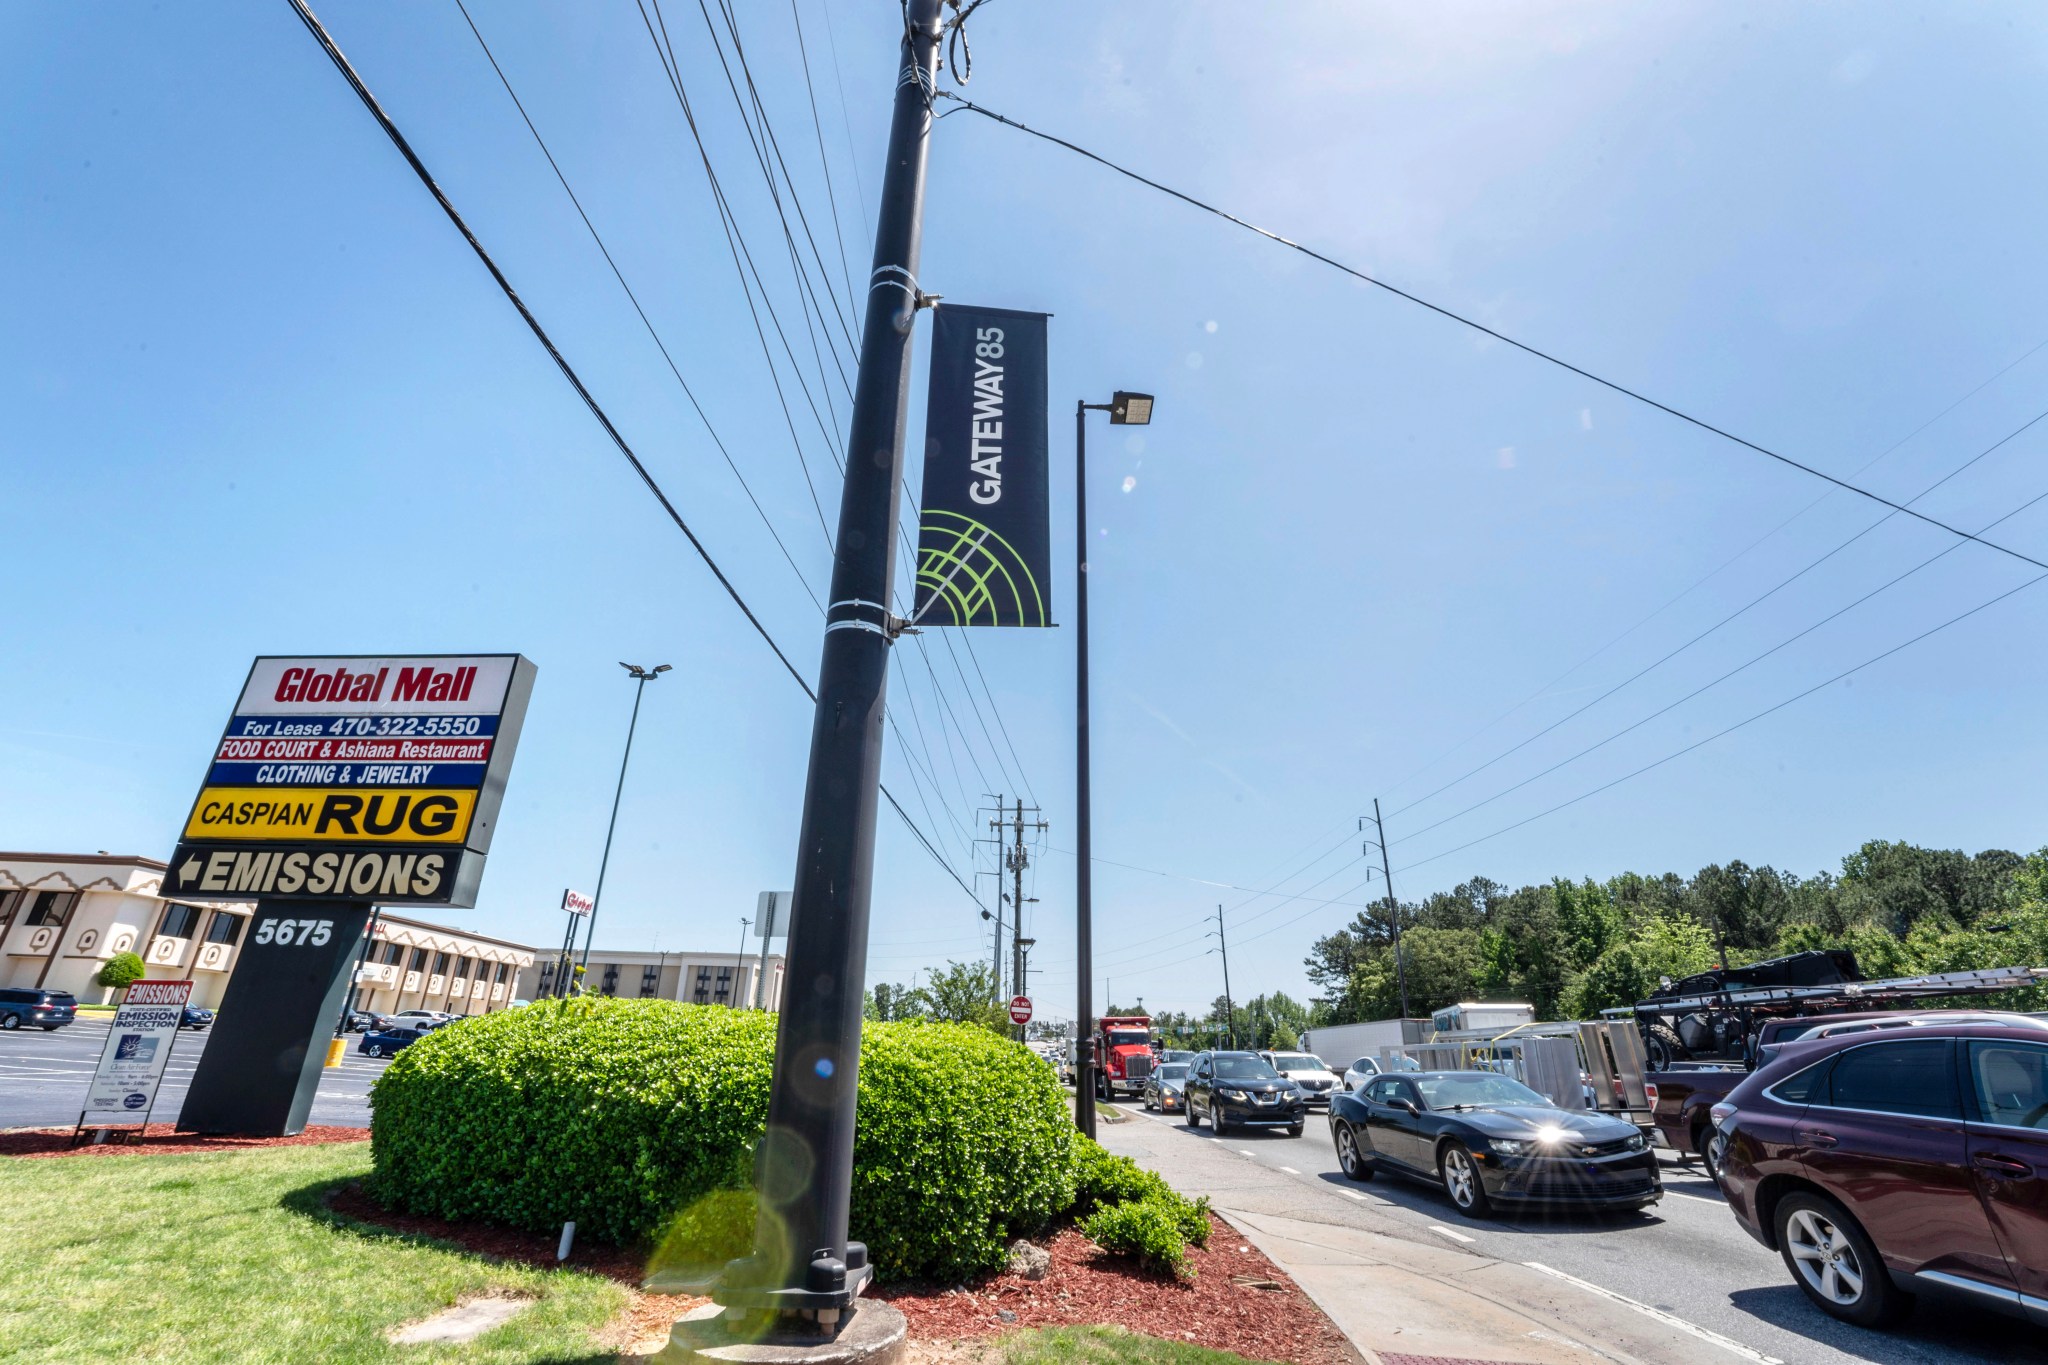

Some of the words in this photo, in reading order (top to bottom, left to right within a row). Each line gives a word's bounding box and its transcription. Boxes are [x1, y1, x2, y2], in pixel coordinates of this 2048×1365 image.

[274, 667, 389, 703] Global
[391, 666, 478, 702] Mall
[243, 720, 272, 736] For
[273, 720, 323, 736] Lease
[329, 717, 480, 736] 470-322-5550
[218, 740, 262, 758] FOOD
[263, 741, 318, 758] COURT
[320, 741, 332, 758] &
[334, 741, 397, 759] Ashiana
[398, 742, 485, 759] Restaurant
[256, 765, 335, 783] CLOTHING
[338, 765, 351, 783] &
[356, 765, 433, 784] JEWELRY
[200, 801, 314, 826] CASPIAN
[314, 795, 459, 835] RUG
[199, 852, 445, 896] EMISSIONS
[255, 919, 333, 946] 5675
[125, 984, 190, 1004] EMISSIONS
[117, 1012, 180, 1020] EMISSION
